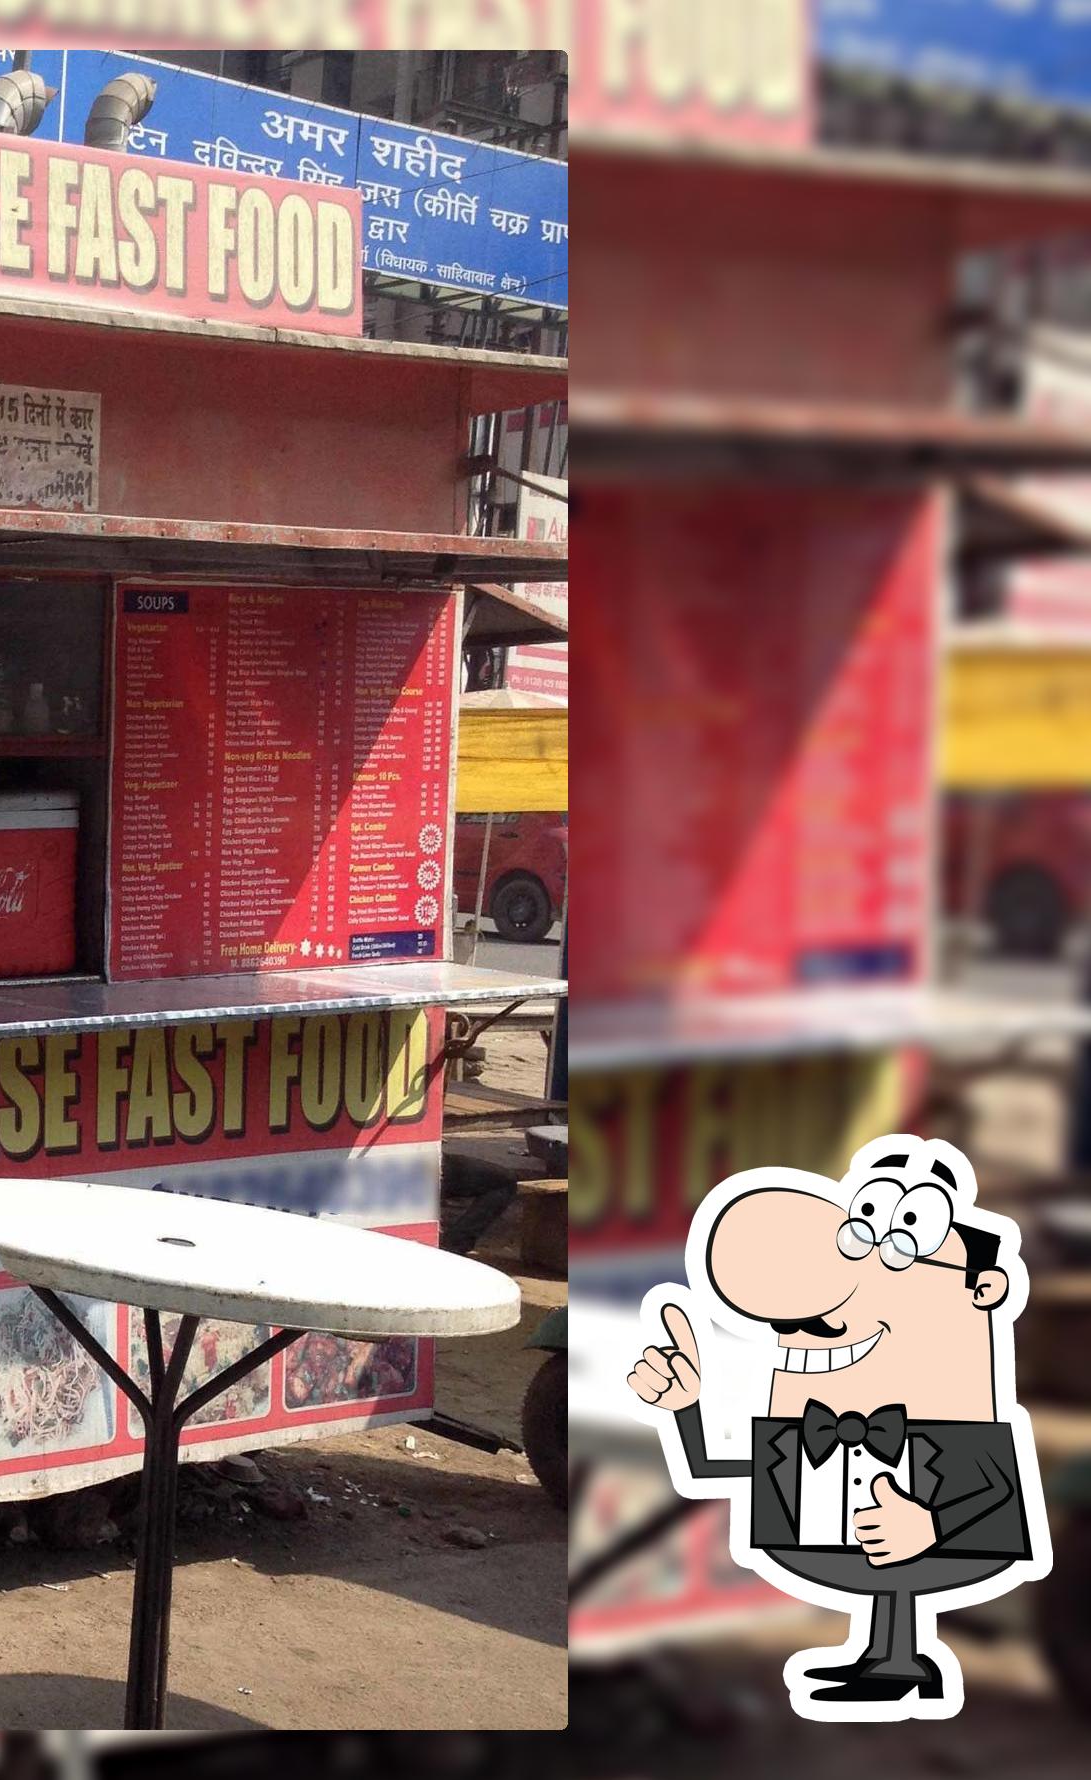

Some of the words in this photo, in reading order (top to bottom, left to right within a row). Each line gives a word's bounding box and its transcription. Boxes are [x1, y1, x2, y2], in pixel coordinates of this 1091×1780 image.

[261, 110, 349, 157] अमर
[370, 136, 466, 184] शहीद
[368, 215, 409, 243] द्वार
[490, 207, 531, 235] चक्र
[47, 158, 193, 292] FAST
[208, 182, 355, 313] FOOD
[137, 595, 175, 610] SOUPS
[220, 944, 238, 956] Free
[240, 943, 262, 955] Home
[96, 1020, 259, 1151] FAST
[270, 1007, 429, 1134] FOOD
